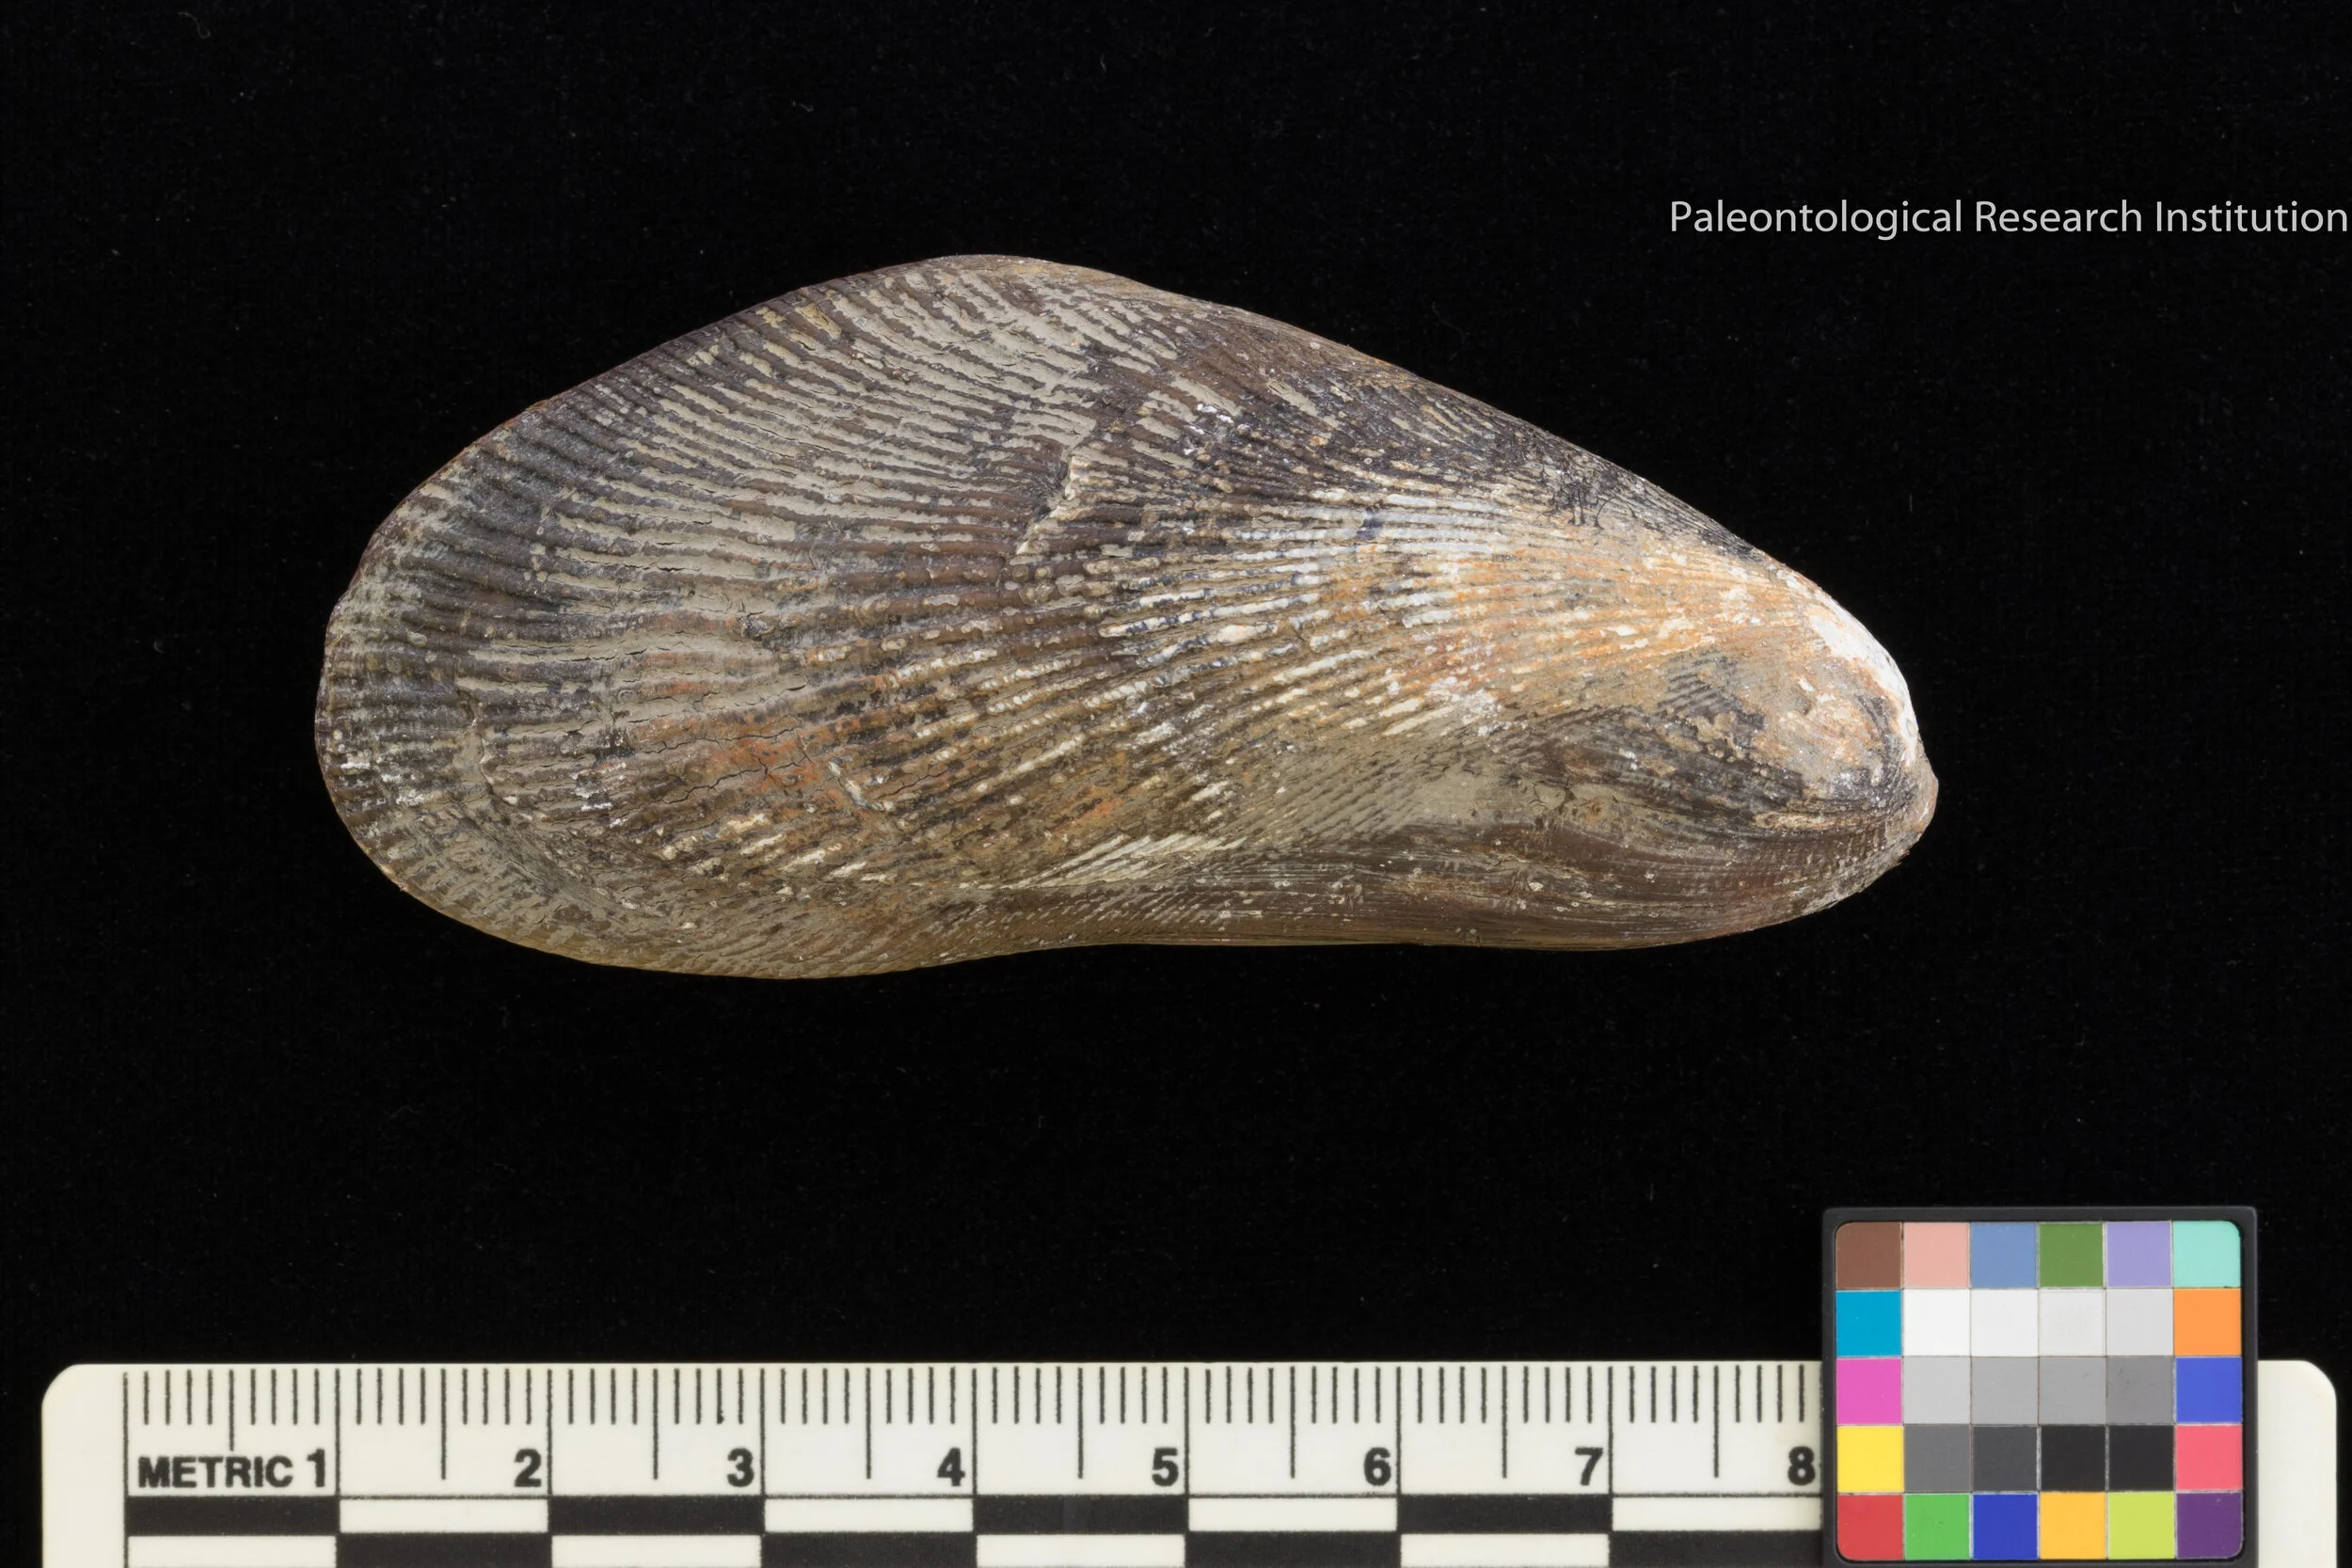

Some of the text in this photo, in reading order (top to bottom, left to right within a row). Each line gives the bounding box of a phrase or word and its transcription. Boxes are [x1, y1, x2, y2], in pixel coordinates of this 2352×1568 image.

[138, 1446, 1817, 1488] METRIC 1 2 3 4 5 6 7 8
